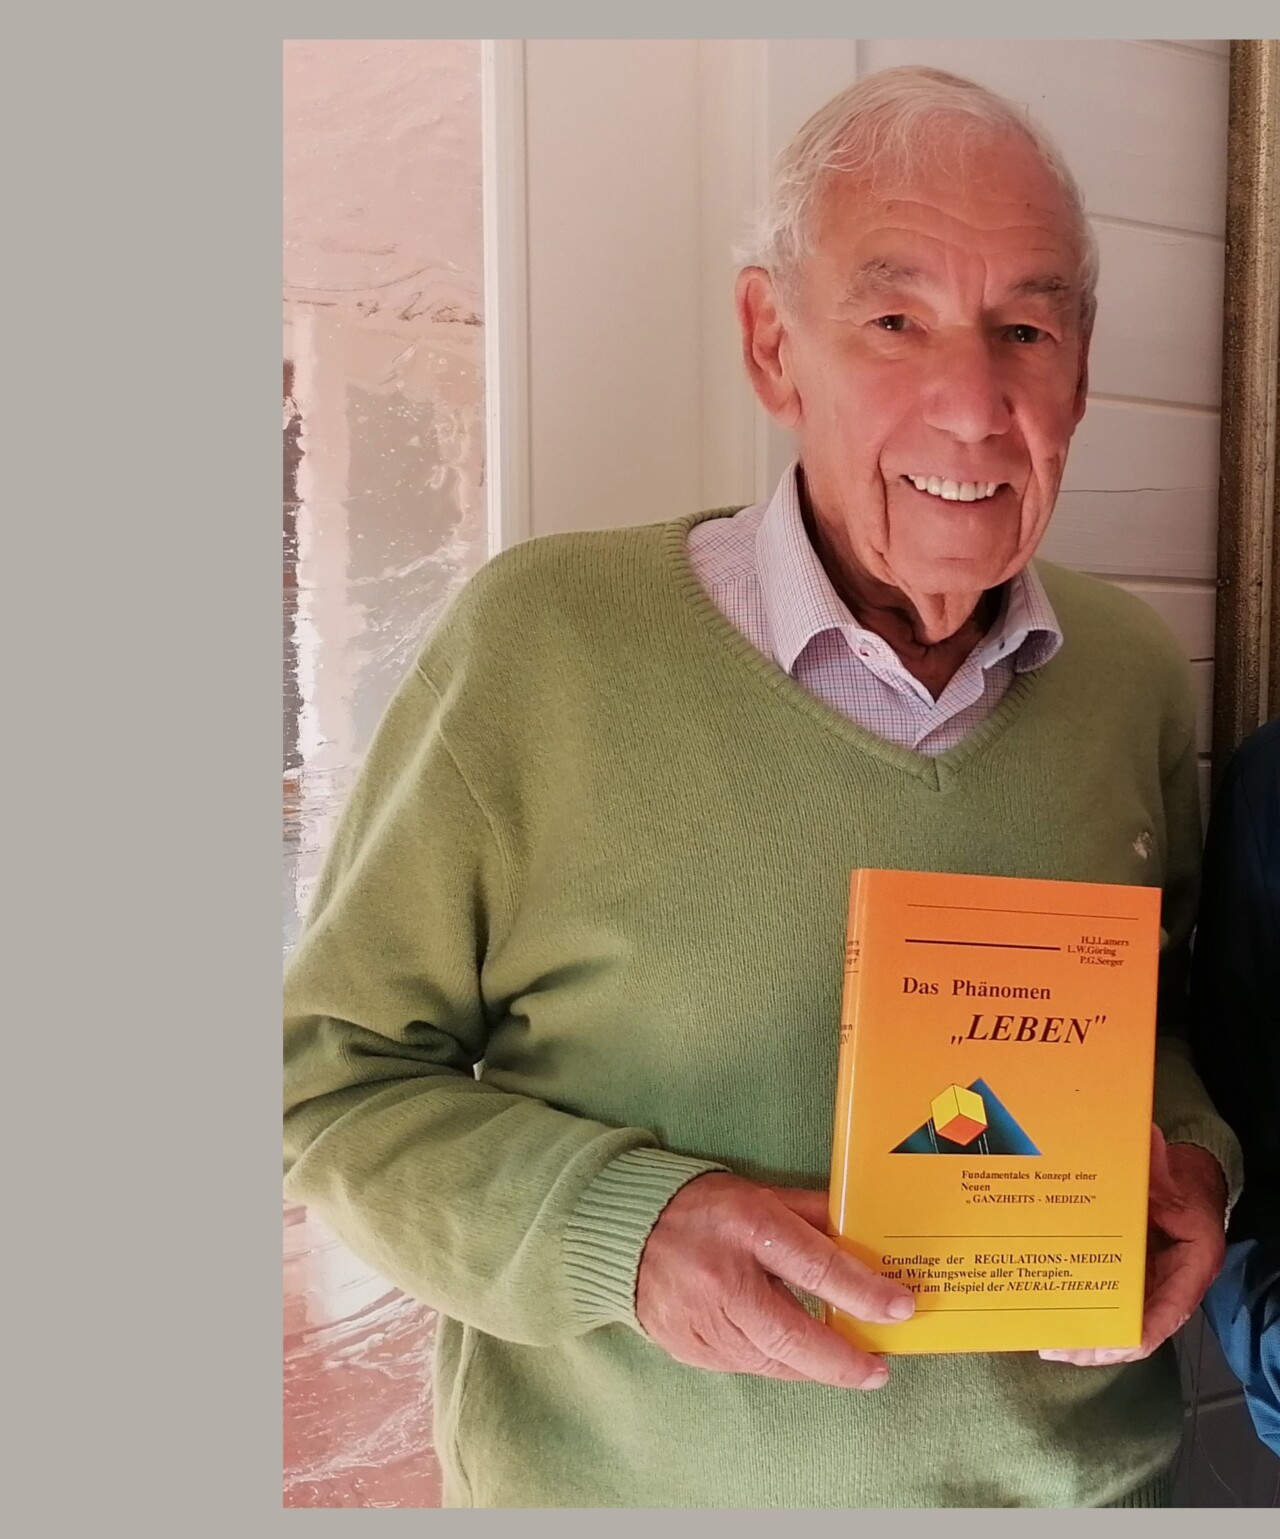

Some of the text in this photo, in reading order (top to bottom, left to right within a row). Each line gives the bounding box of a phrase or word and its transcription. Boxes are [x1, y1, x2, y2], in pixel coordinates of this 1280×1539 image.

[902, 976, 1051, 1000] Das Phänomen
[961, 1170, 1097, 1182] Fundamentales Konzept einer
[961, 1182, 991, 1191] Neuen
[881, 1254, 941, 1267] Grundlage
[946, 1254, 965, 1265] der
[906, 1268, 987, 1280] Wirkungsweise
[990, 1268, 1014, 1279] aller
[1017, 1267, 1073, 1280] Therapien.
[924, 1284, 941, 1293] am
[944, 1281, 985, 1294] Beispiel
[987, 1281, 1005, 1292] der
[1007, 1280, 1120, 1292] NEURAL-THERAPIE
